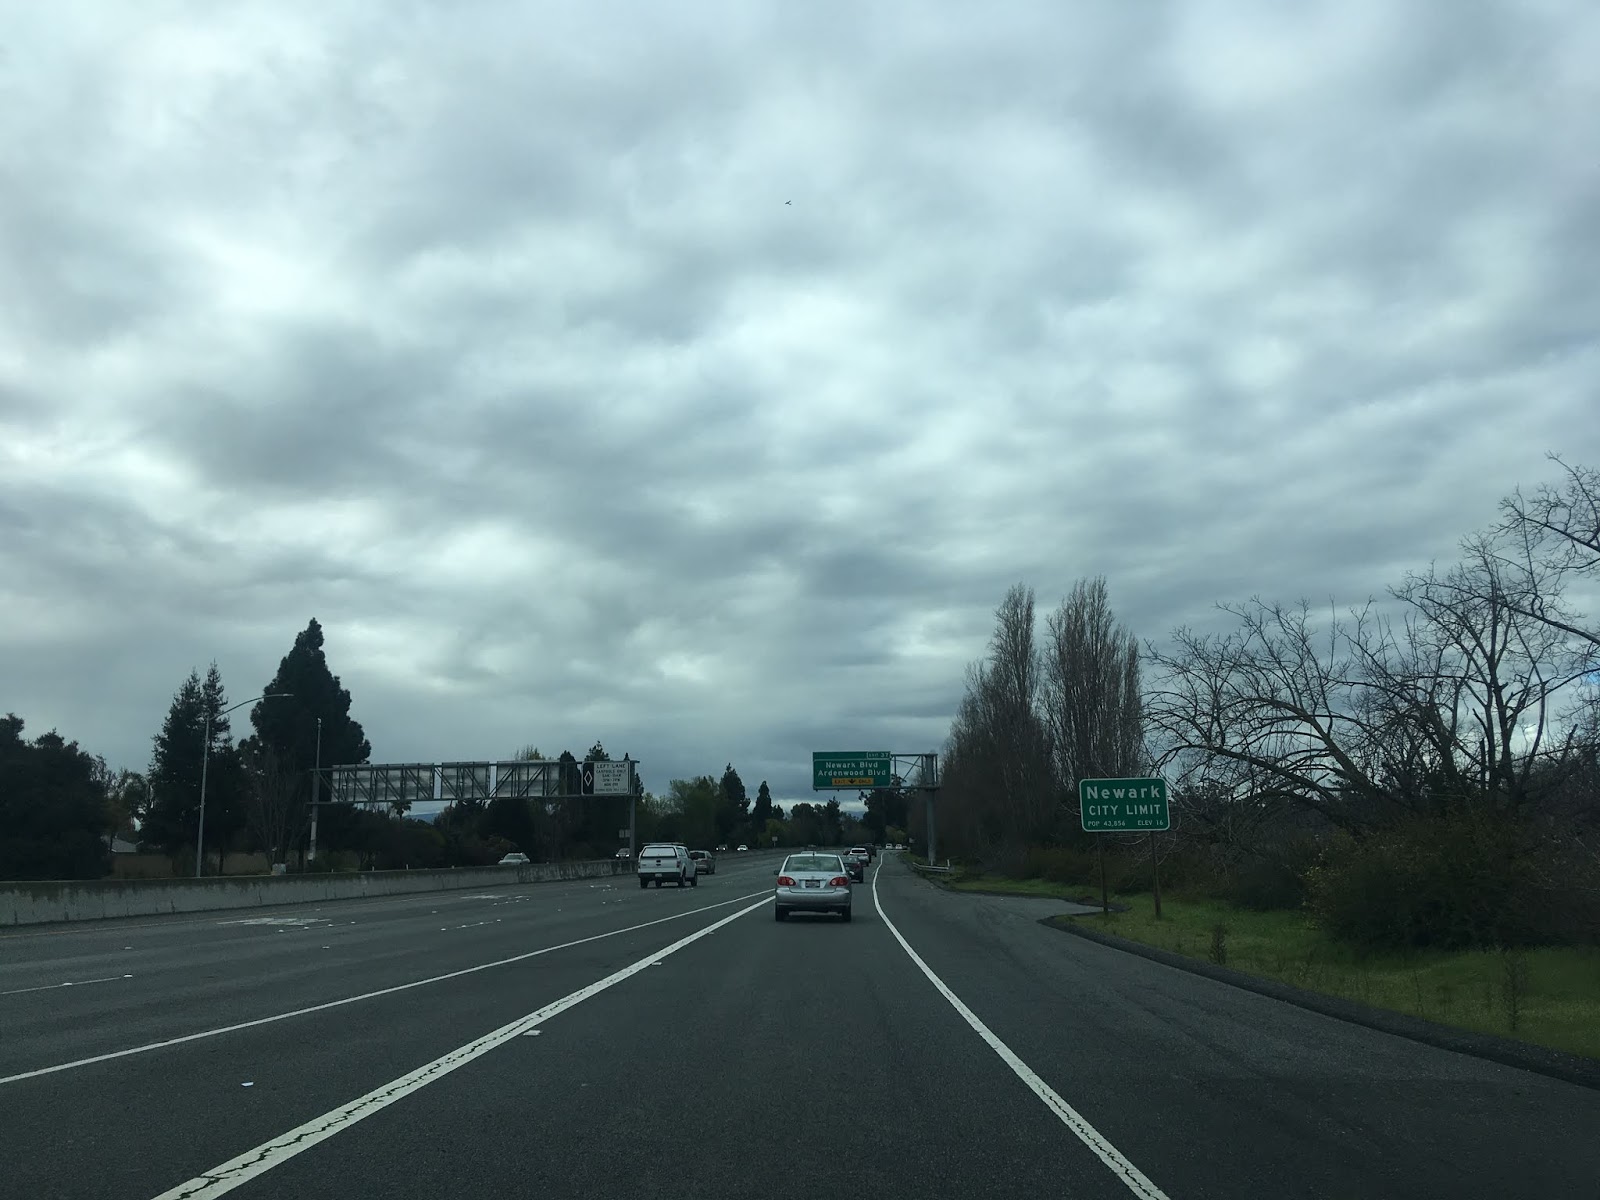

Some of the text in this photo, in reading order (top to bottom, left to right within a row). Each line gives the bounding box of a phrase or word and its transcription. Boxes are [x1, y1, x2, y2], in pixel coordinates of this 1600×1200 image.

[1086, 785, 1161, 799] Newark
[1088, 804, 1161, 816] CITY LIMIT
